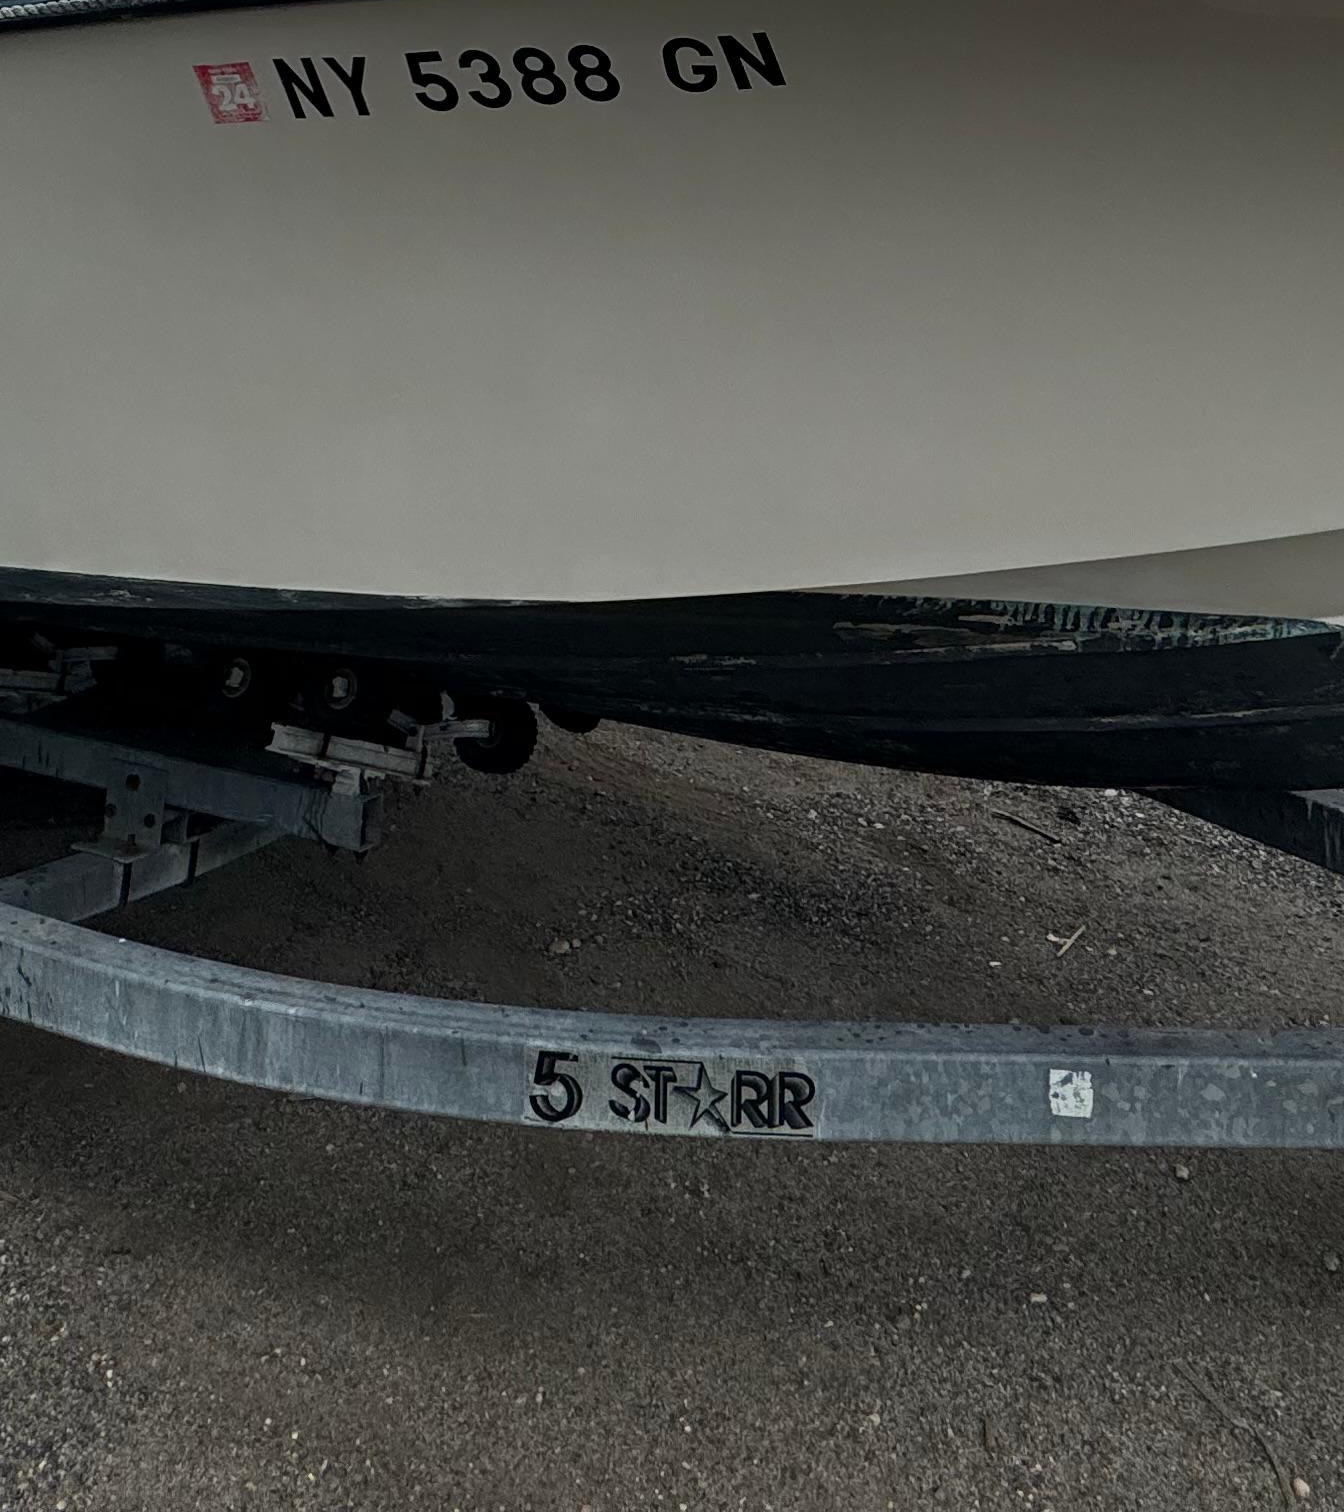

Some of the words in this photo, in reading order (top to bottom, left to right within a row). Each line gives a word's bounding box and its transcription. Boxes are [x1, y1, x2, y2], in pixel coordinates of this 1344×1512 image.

[272, 56, 370, 119] NY
[405, 44, 621, 112] 5388
[662, 32, 787, 93] GN
[529, 1051, 583, 1122] 5
